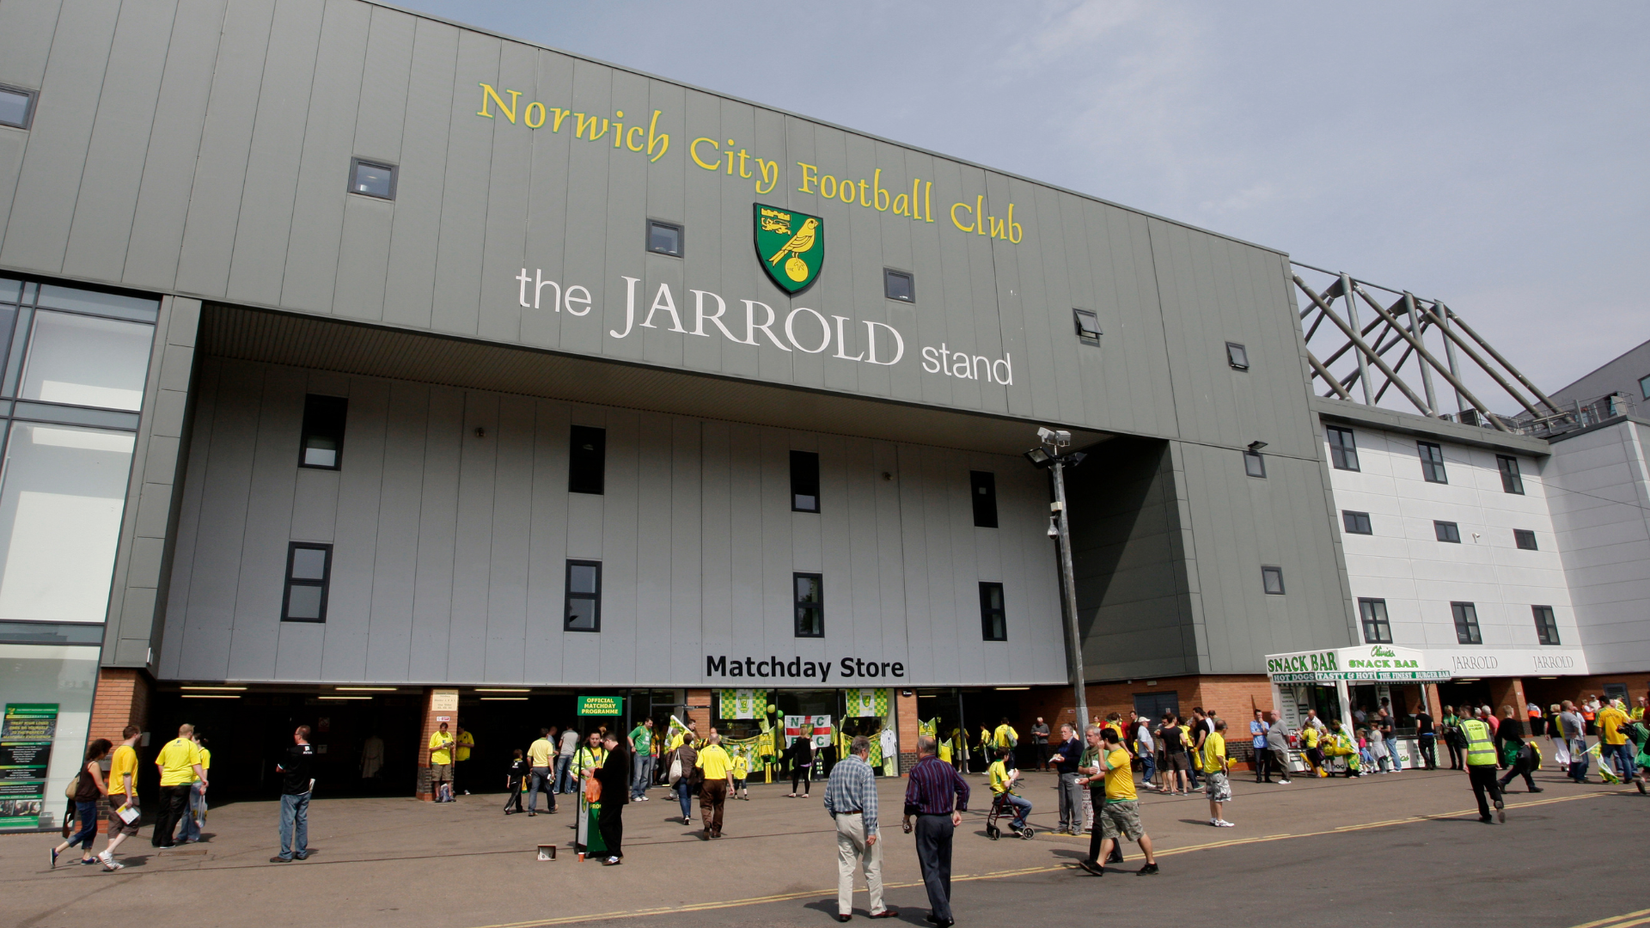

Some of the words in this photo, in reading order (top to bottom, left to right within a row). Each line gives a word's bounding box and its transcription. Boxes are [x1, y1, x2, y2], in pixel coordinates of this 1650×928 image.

[476, 82, 670, 164] Norwich
[689, 136, 779, 195] City
[796, 161, 935, 223] Football
[950, 194, 1023, 245] Club
[515, 268, 592, 317] the
[609, 275, 904, 366] JARROLD
[922, 342, 1013, 386] stand
[706, 655, 832, 683] Matchday
[840, 657, 904, 678] Store
[1267, 655, 1309, 673] SNACK
[1310, 652, 1338, 671] BAR
[1348, 659, 1391, 668] SNACK
[1394, 659, 1418, 668] BAR
[1452, 656, 1498, 673] JARROLD
[1533, 655, 1574, 672] JARROLD
[1415, 671, 1438, 679] BURGER
[791, 717, 799, 726] N
[817, 717, 824, 726] C
[816, 736, 824, 746] C
